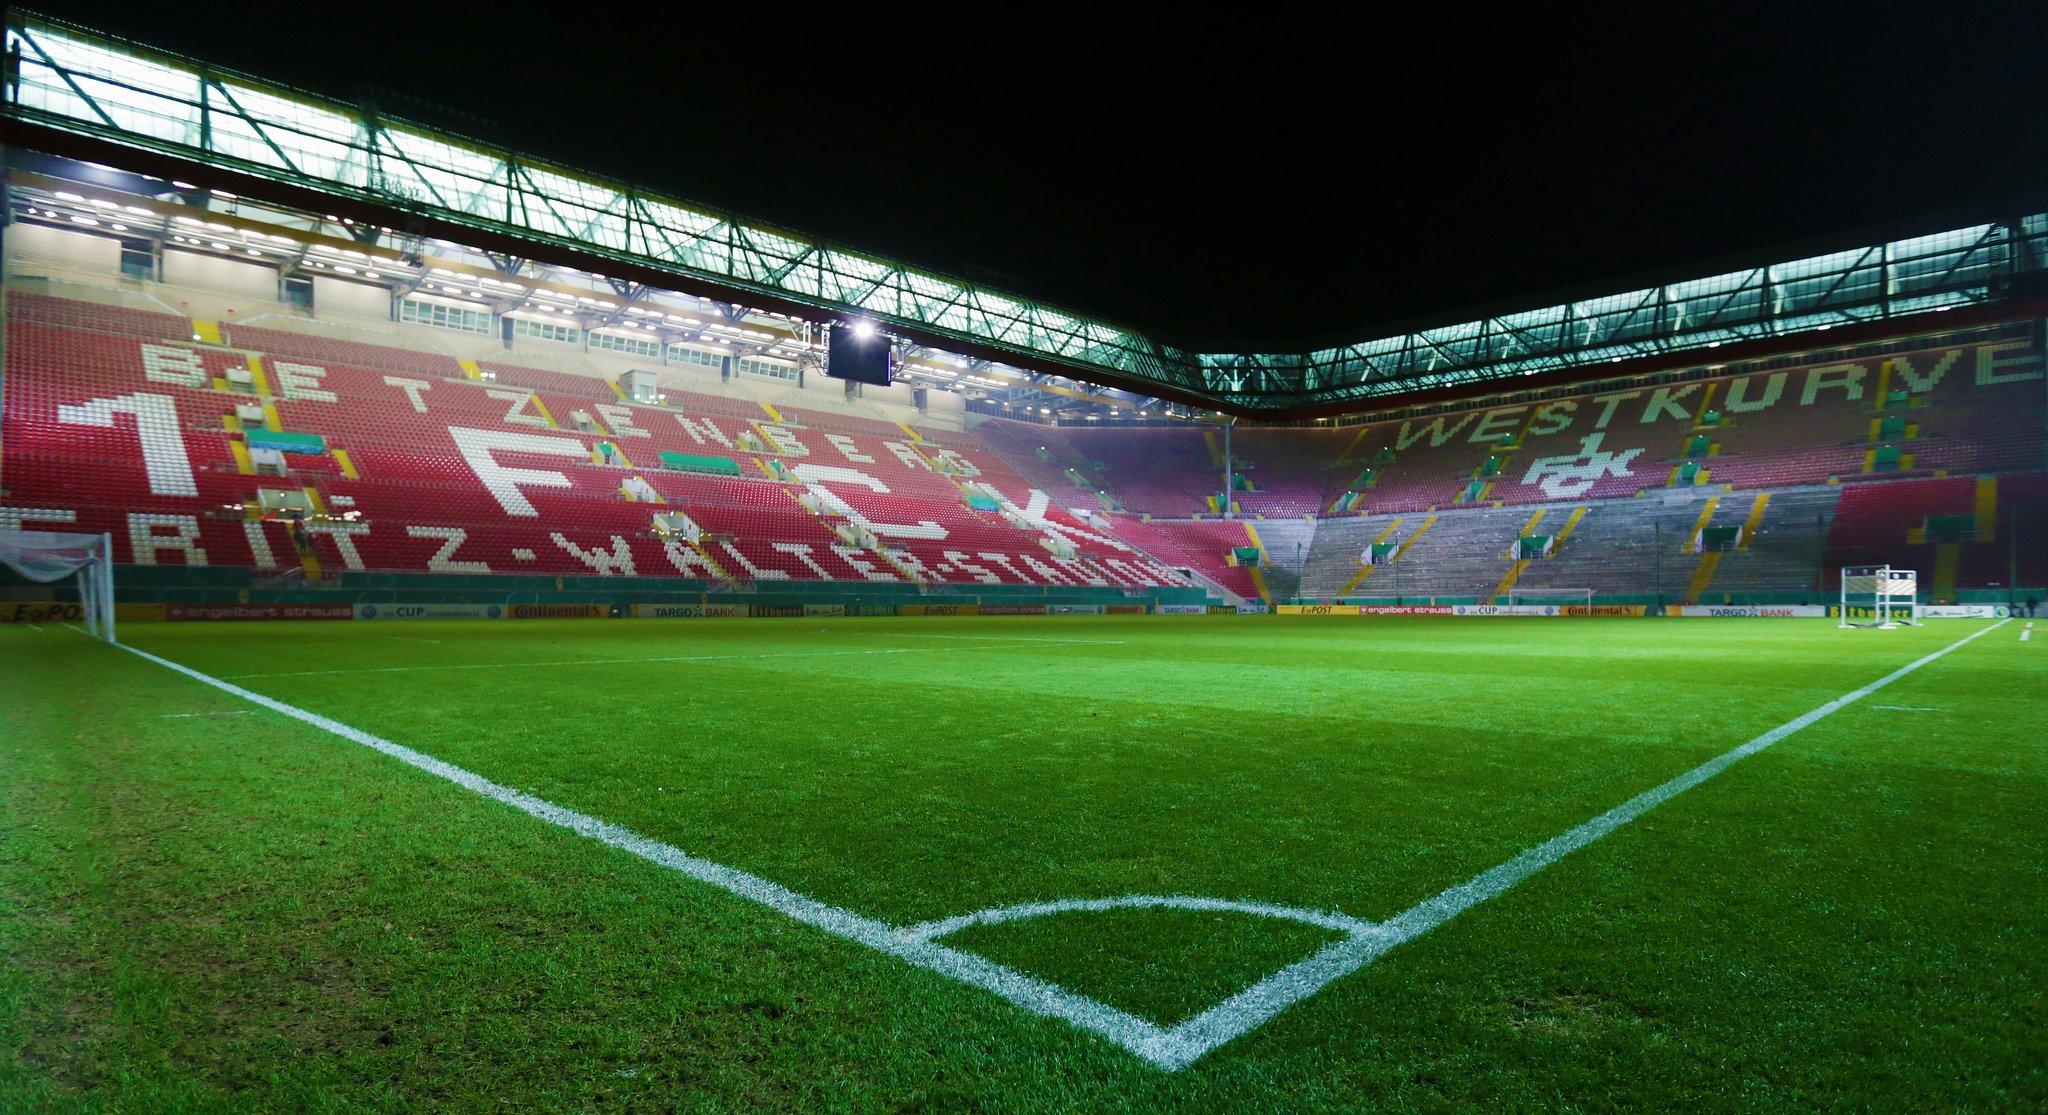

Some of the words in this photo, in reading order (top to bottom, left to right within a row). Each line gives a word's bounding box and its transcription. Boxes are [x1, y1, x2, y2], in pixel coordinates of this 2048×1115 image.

[1396, 340, 2044, 451] WESTKURVE
[187, 605, 278, 619] engelbert
[284, 607, 352, 617] strauss
[397, 607, 424, 617] CUP
[514, 604, 589, 618] Continental
[1368, 606, 1412, 614] engelbert
[1479, 606, 1497, 615] CUP
[1568, 605, 1622, 616] Contnental
[1830, 607, 1909, 619] Btburer
